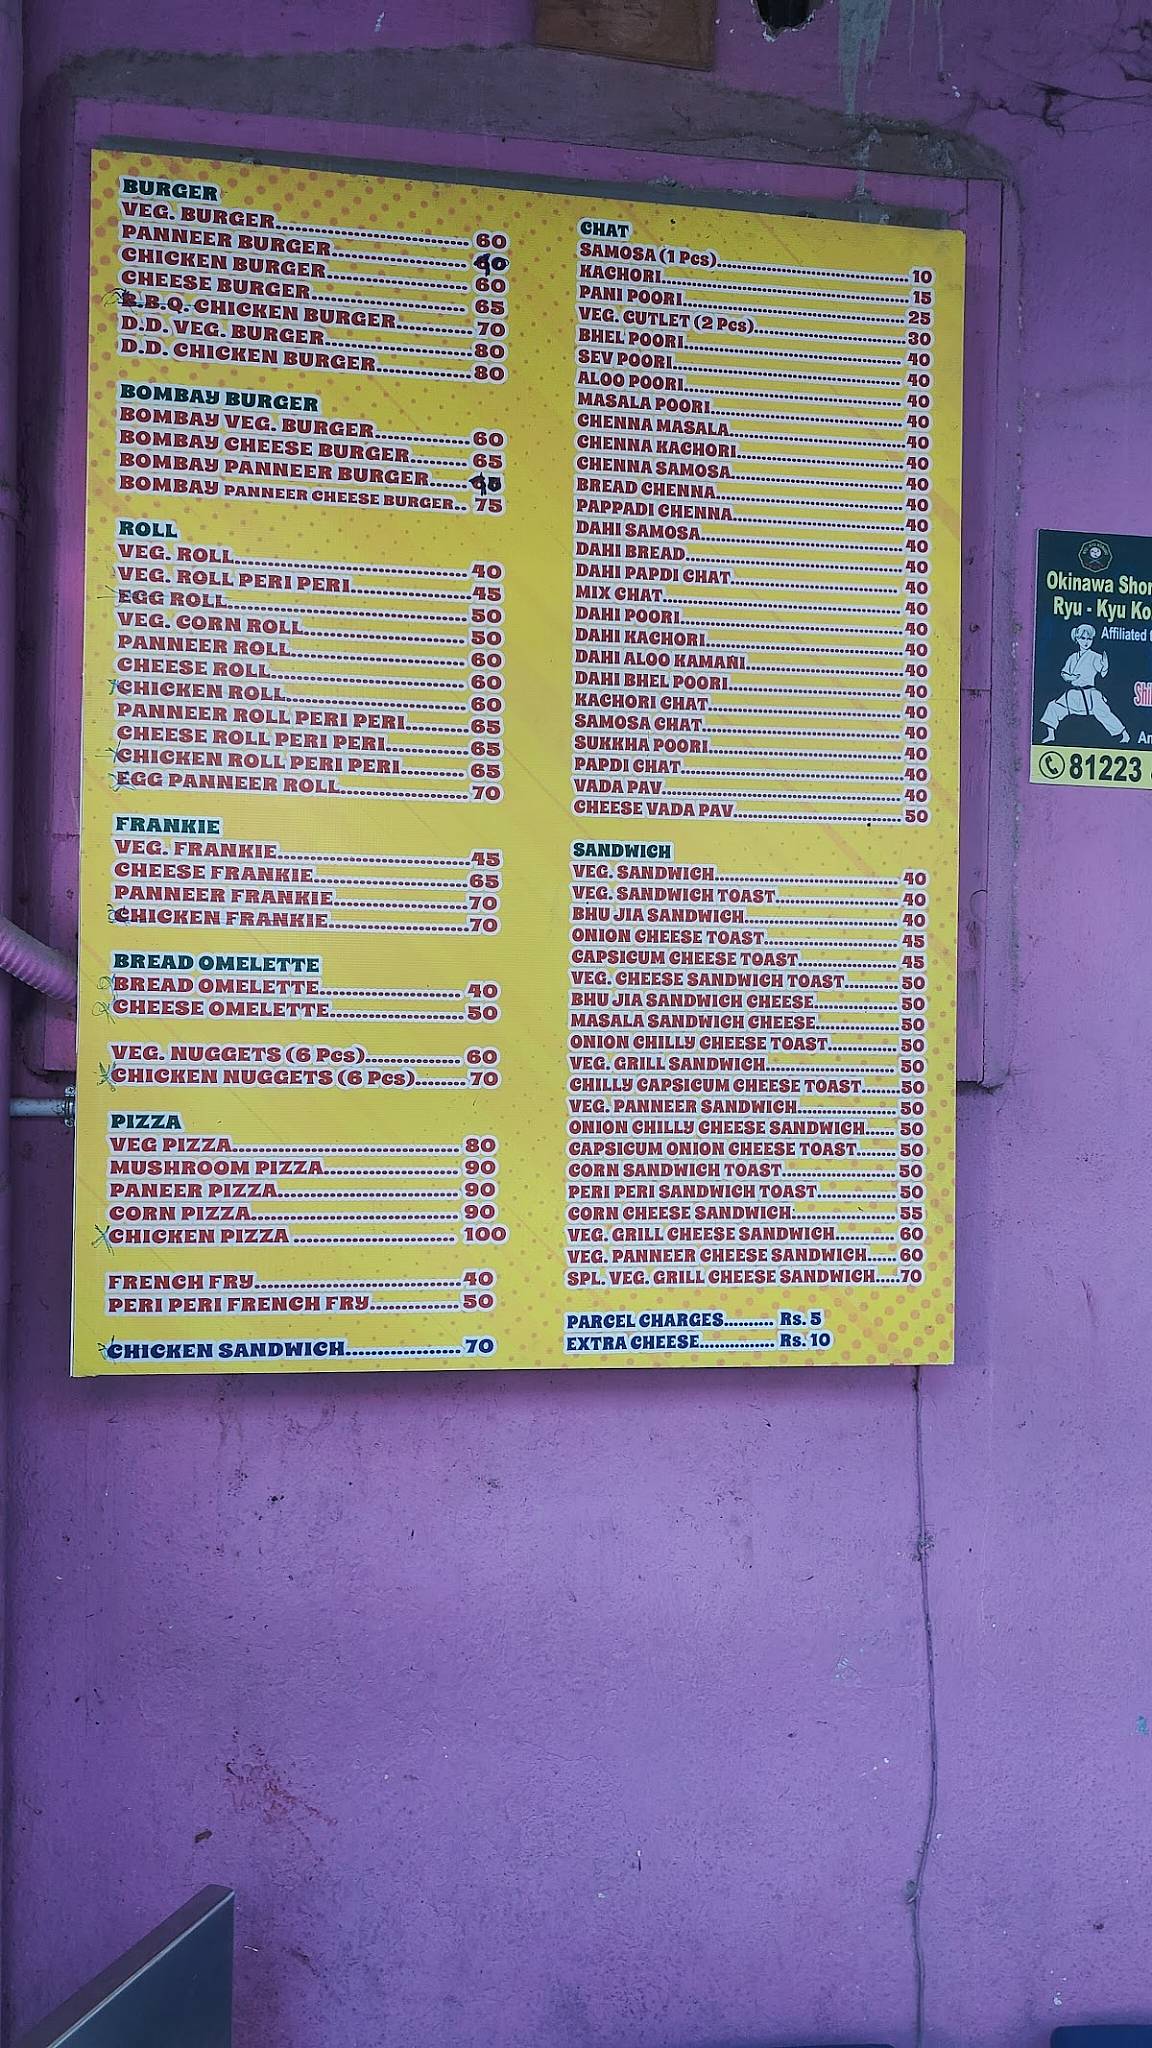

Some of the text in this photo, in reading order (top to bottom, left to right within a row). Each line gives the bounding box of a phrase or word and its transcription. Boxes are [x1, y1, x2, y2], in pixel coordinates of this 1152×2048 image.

[123, 178, 217, 202] BURGER
[121, 201, 506, 249] VEG. BURGER 60
[580, 220, 629, 239] CHAT
[580, 241, 932, 284] SAMOSA (1 Pcs) 10
[121, 269, 504, 315] CHEESE BURGER 65
[579, 284, 930, 325] PANI POORI 25
[578, 349, 930, 387] SEV POORI 40
[120, 383, 318, 412] BOMBAY BURGER
[577, 391, 929, 428] MASALA POORI 40
[119, 429, 502, 469] BOMBAY CHEESE BURGER 65
[577, 455, 928, 491] CHENNA SAMOSA 40
[577, 498, 928, 532] PAPPADI CHENNA 40
[119, 520, 178, 538] ROLL
[118, 543, 501, 579] VEG. ROLL 40
[575, 562, 927, 594] DAHI PAPDI CHAT 40
[1047, 570, 1114, 593] Okinawa
[575, 606, 927, 636] DAHI POORI 40
[1053, 596, 1082, 620] Ryu
[1097, 599, 1126, 622] Kyu
[117, 612, 501, 646] VEG. CORN ROLL 50
[1101, 626, 1147, 641] Affiliated
[117, 657, 501, 690] CHEESE ROLL 60
[575, 692, 927, 719] KACHORI CHAT 40
[117, 725, 500, 756] CHEESE ROLL PERI PERI 65
[574, 734, 927, 760] SUKKHA POORI 40
[1070, 752, 1141, 782] 81223
[117, 770, 500, 800] EGG PANNEER ROLL 70
[574, 799, 928, 823] CHEESE VADA PAV 50
[116, 816, 219, 834] FRANKIE
[573, 841, 671, 860] SANDWICH
[115, 885, 497, 910] PANNEER FRANKIE 70
[572, 885, 925, 906] VEG. SANDWICH TOAST 40
[113, 907, 497, 932] CHICKEN FRANKIE 70
[113, 953, 319, 973] BREAD OMELETTE
[111, 976, 497, 998] BREAD OMELETTE 40
[571, 970, 925, 990] VEG. CHEESE SANDWICH TOAST 50
[570, 1034, 924, 1052] ONION CHILLY CHEESE TOAST 50
[110, 1067, 498, 1087] CHICKEN NUGGETS (6 Pcs) 70
[569, 1098, 924, 1115] VEG. PANNEER SANDWICH 50
[111, 1114, 182, 1129] PIZZA
[569, 1141, 923, 1156] CAPSICUM ONION CHEESE TOAST 50
[110, 1160, 495, 1176] MUSHROOM PIZZA 90
[568, 1205, 922, 1220] CORN CHEESE SANDWICH 55
[108, 1226, 506, 1243] CHICKEN PIZZA 100
[567, 1248, 923, 1263] VEG. PANNEER CHEESE SANDWICH 60
[108, 1294, 493, 1313] PERI PERI FRENCH FRY 50
[567, 1311, 821, 1328] PARCEL CHARGES Rs. 5
[567, 1333, 830, 1350] EXTRA CHEESE Rs. 10
